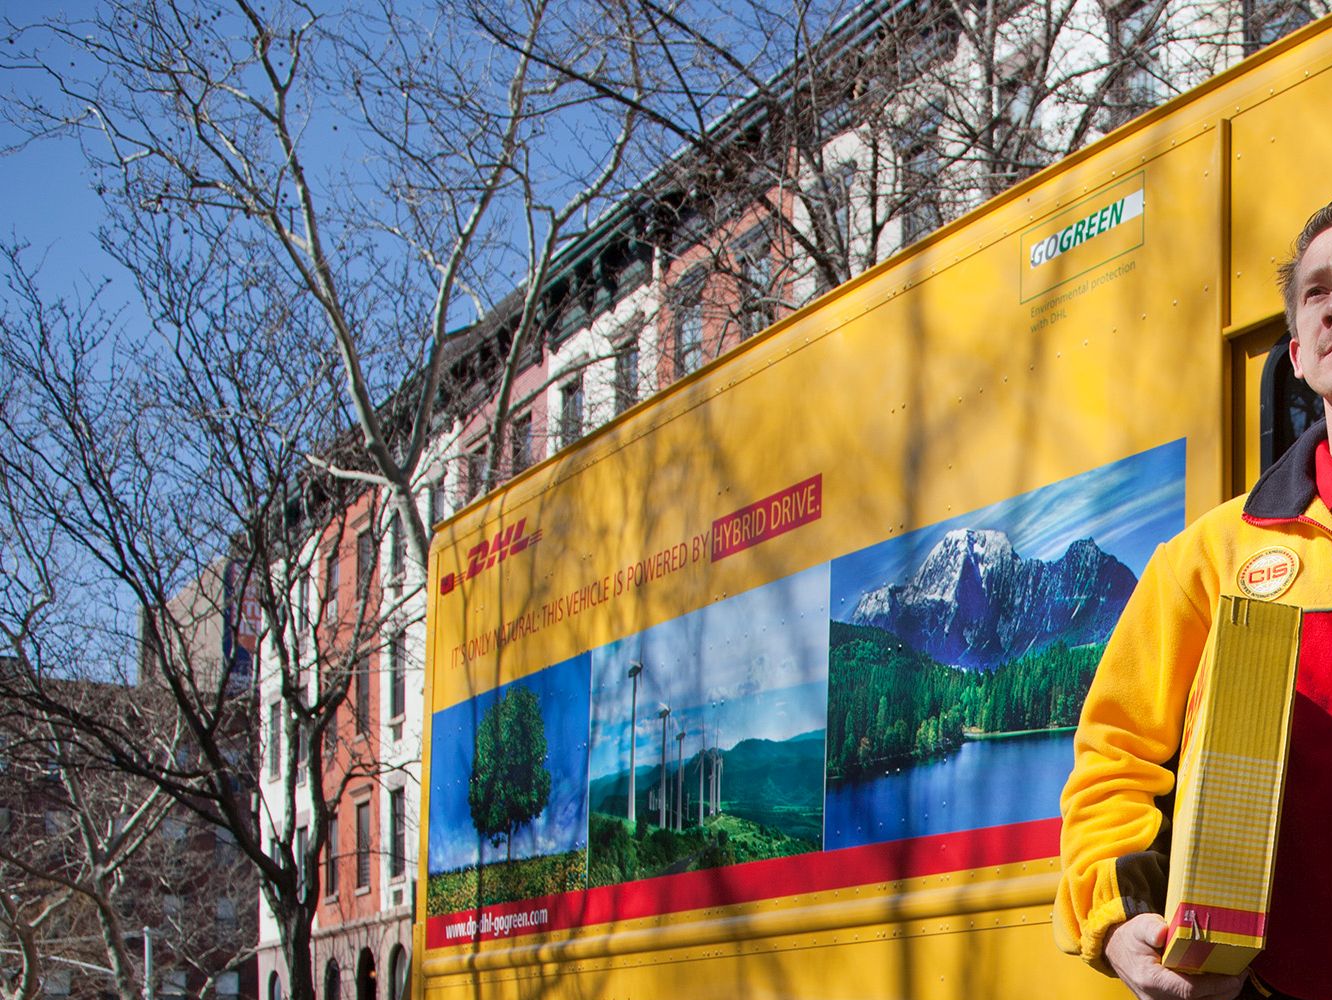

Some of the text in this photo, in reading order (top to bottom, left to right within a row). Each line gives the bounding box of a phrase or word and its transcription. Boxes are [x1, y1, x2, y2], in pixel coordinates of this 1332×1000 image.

[1031, 199, 1125, 268] GOGREEN
[1031, 260, 1136, 318] Environmental protection
[1030, 309, 1067, 333] with DHL
[465, 516, 530, 581] DHL
[468, 631, 492, 661] ONLY
[494, 614, 540, 650] NATURAL:
[542, 598, 564, 629] THIS
[565, 576, 610, 617] VEHICLE
[613, 570, 624, 597] IS
[627, 542, 688, 591] POWERED
[692, 530, 710, 563] BY
[713, 507, 766, 554] HYBRID
[770, 484, 820, 530] DRIVE.
[1248, 563, 1288, 584] CIS
[445, 908, 548, 940] www.dp-dhl-gogreen.com
